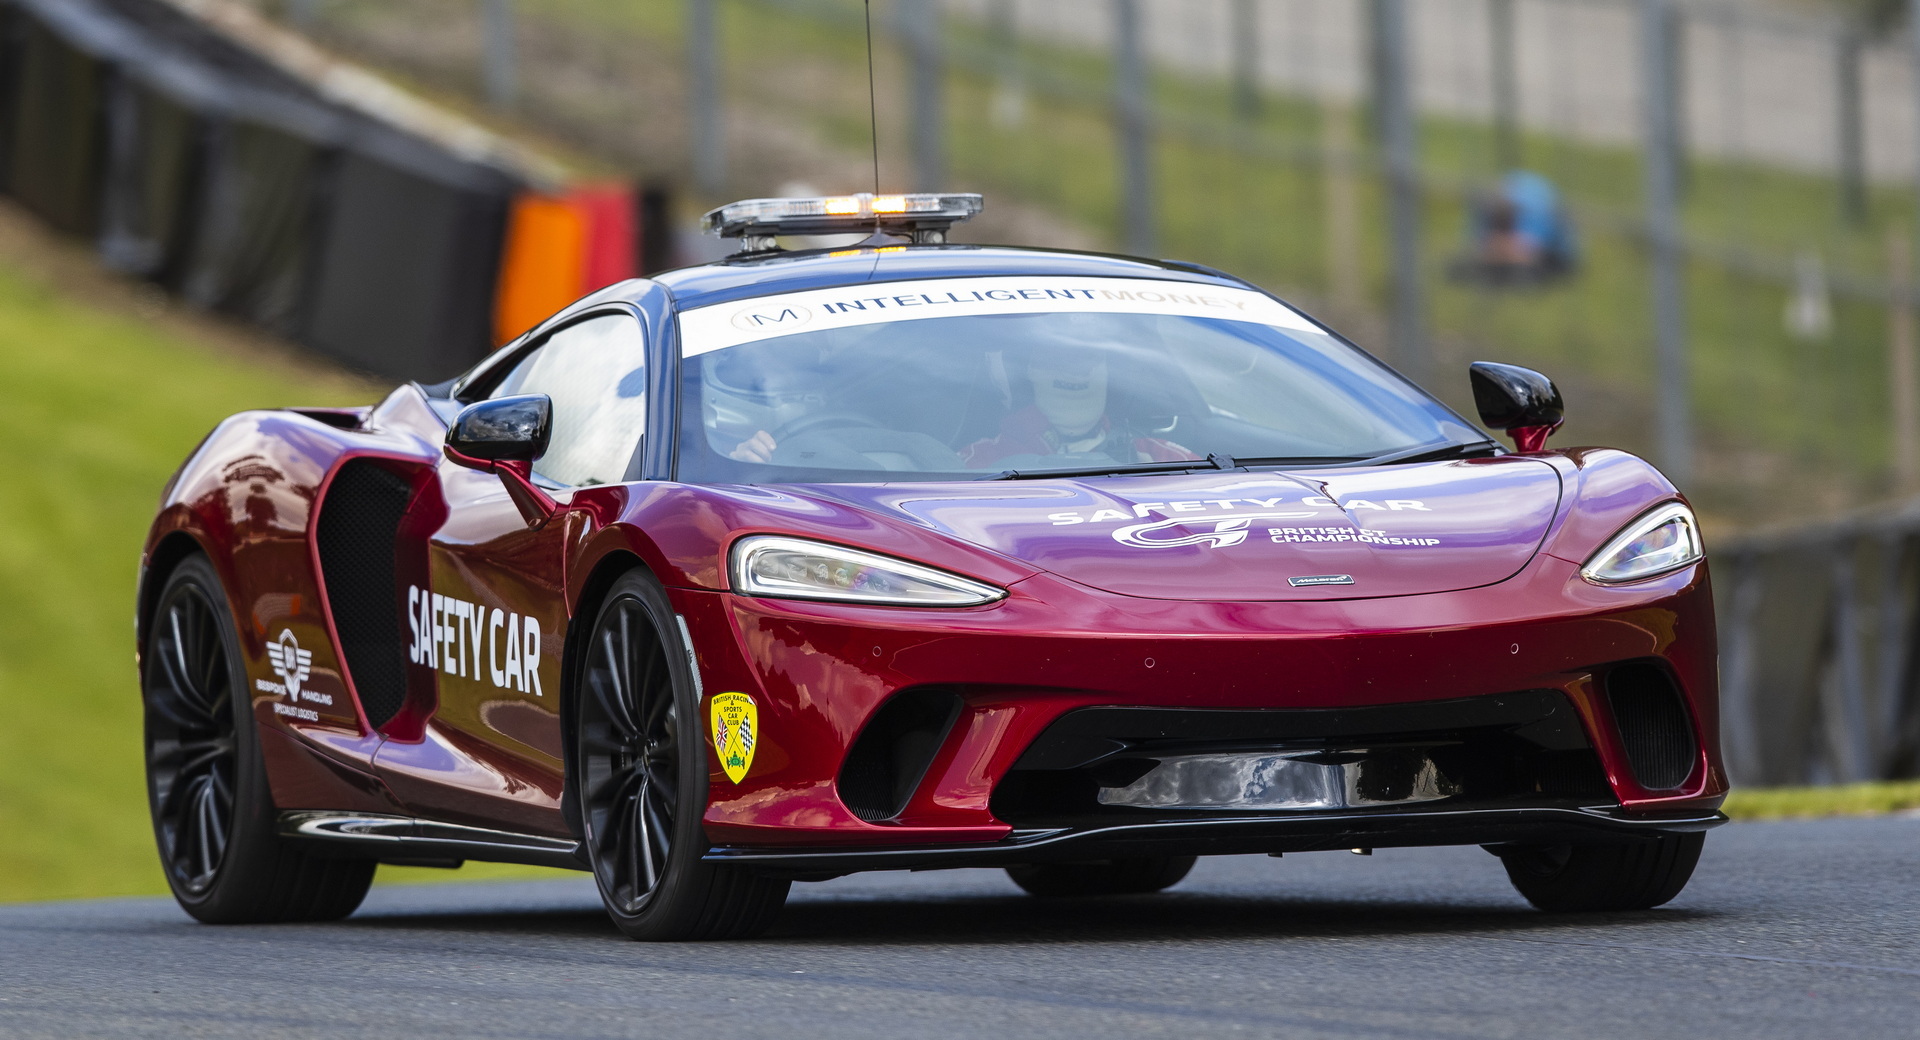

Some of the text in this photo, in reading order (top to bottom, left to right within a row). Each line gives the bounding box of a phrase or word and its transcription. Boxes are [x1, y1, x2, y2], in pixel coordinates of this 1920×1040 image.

[1048, 496, 1432, 526] SAFETY CAR
[1267, 527, 1386, 538] BRITISH GT
[1270, 534, 1441, 546] CHAMPIONSHIP
[408, 584, 543, 696] SAFETY CAR
[302, 689, 333, 705] HANDLING
[714, 696, 731, 704] BRITISH
[274, 703, 318, 721] SPECIALIST LOGISTICS
